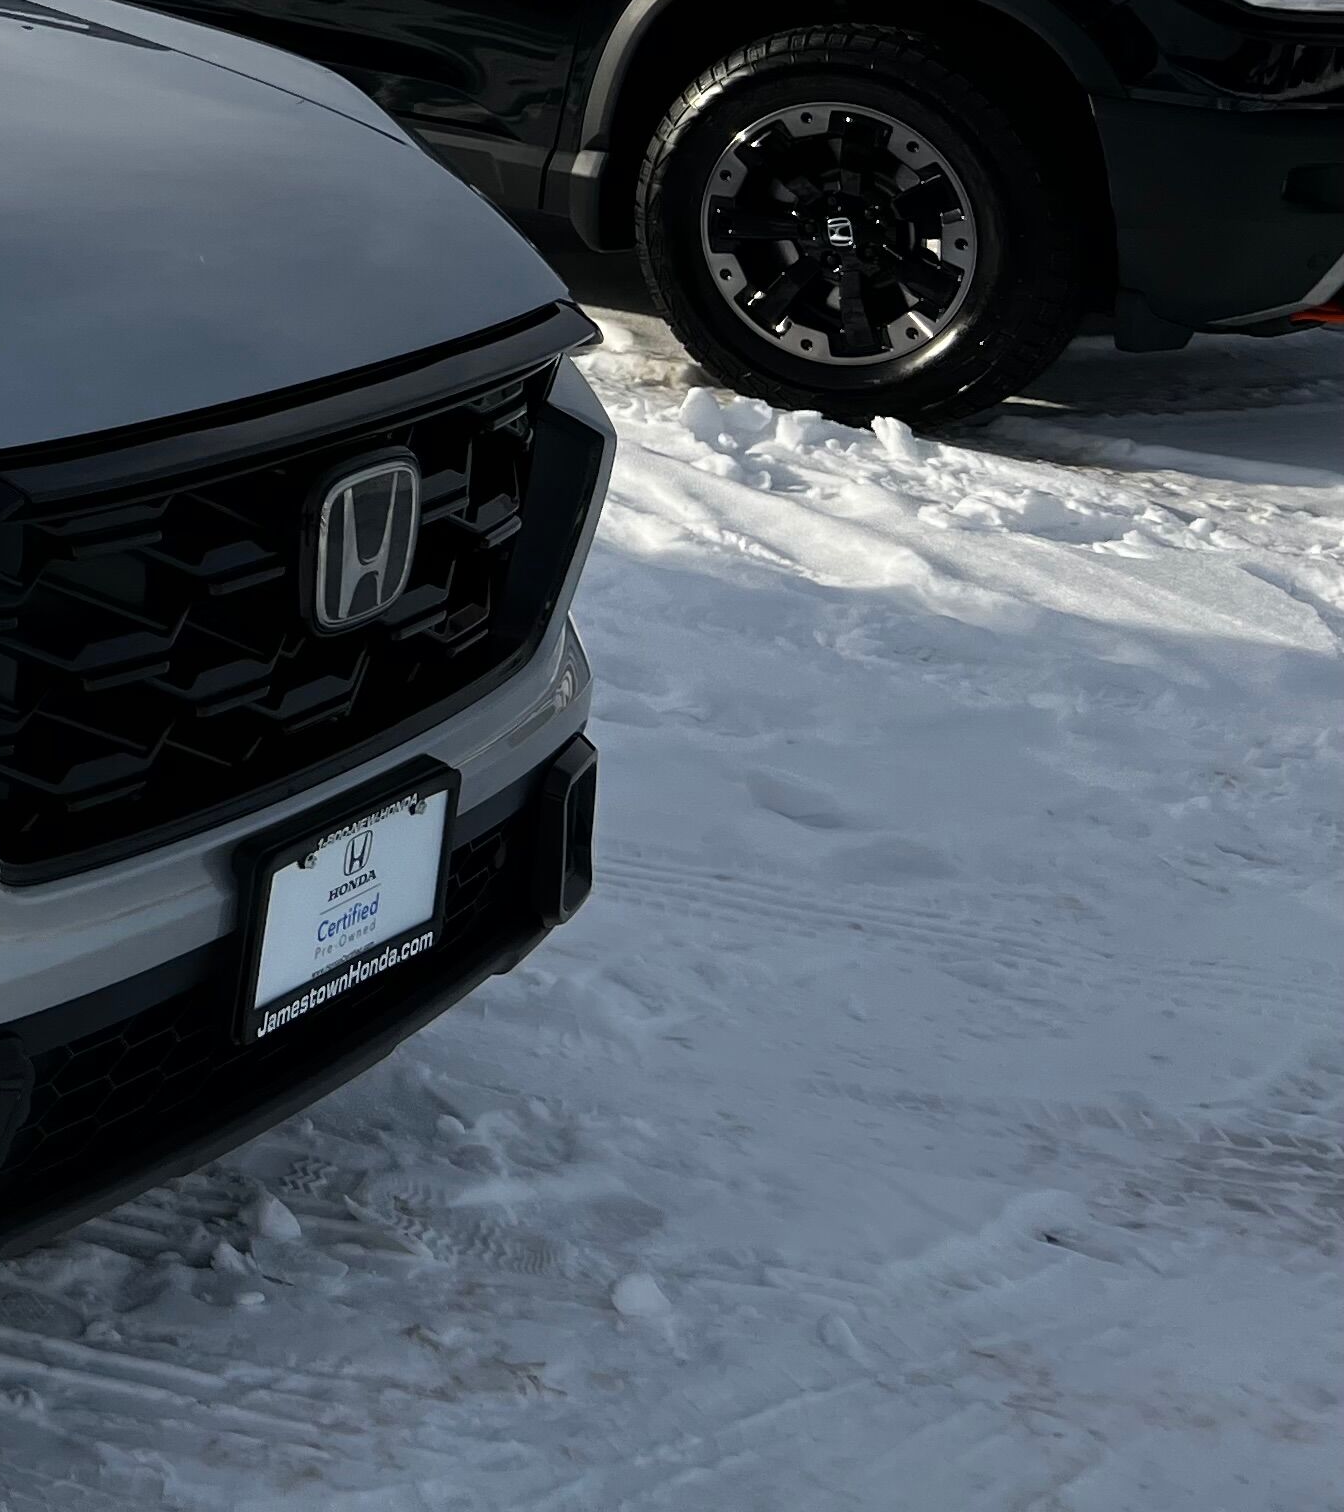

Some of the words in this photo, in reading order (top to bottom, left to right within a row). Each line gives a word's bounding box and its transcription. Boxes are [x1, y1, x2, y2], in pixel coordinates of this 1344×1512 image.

[328, 870, 377, 902] HONDA
[317, 892, 380, 942] Certified
[257, 931, 433, 1037] JamestownHonda.com
